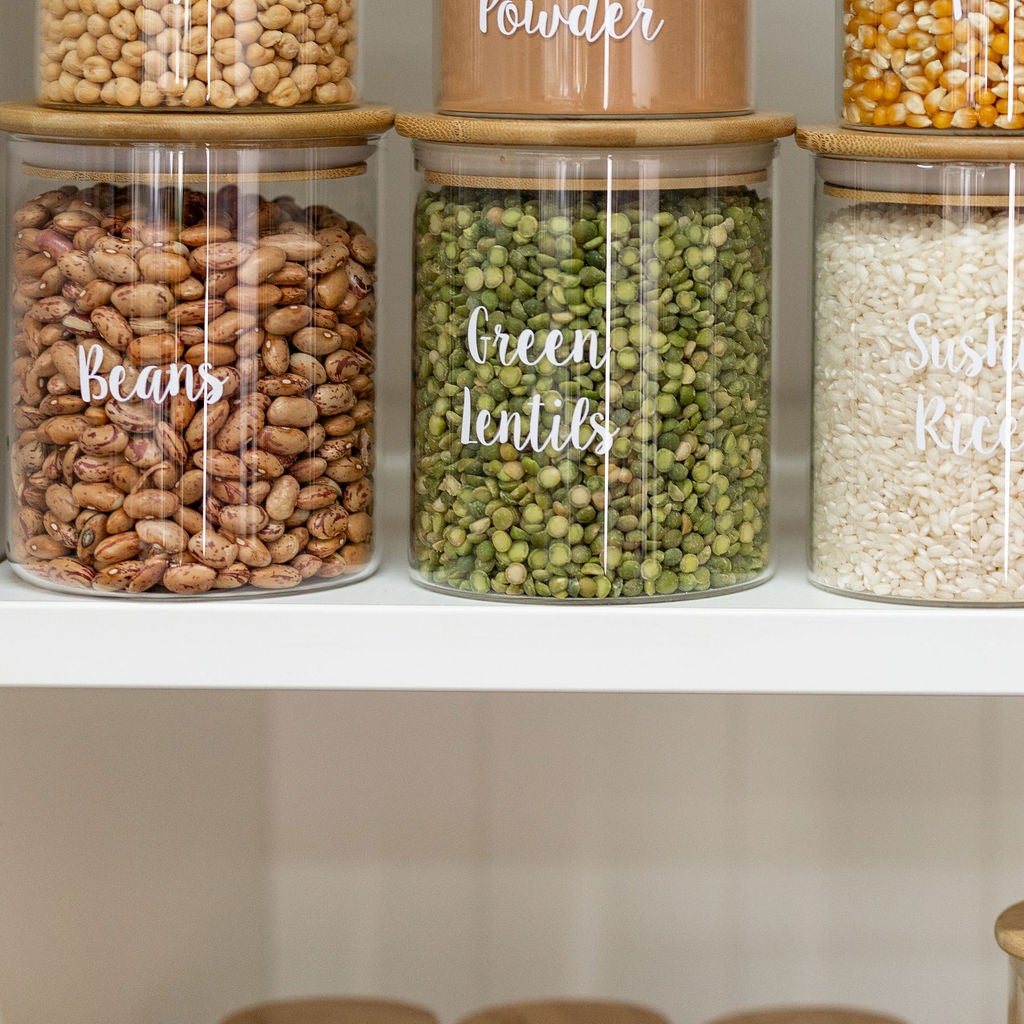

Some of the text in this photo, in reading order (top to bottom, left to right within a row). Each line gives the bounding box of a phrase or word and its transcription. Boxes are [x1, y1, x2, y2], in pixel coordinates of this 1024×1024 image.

[466, 304, 612, 369] Green
[76, 344, 230, 407] Beans
[459, 386, 620, 456] Lentils
